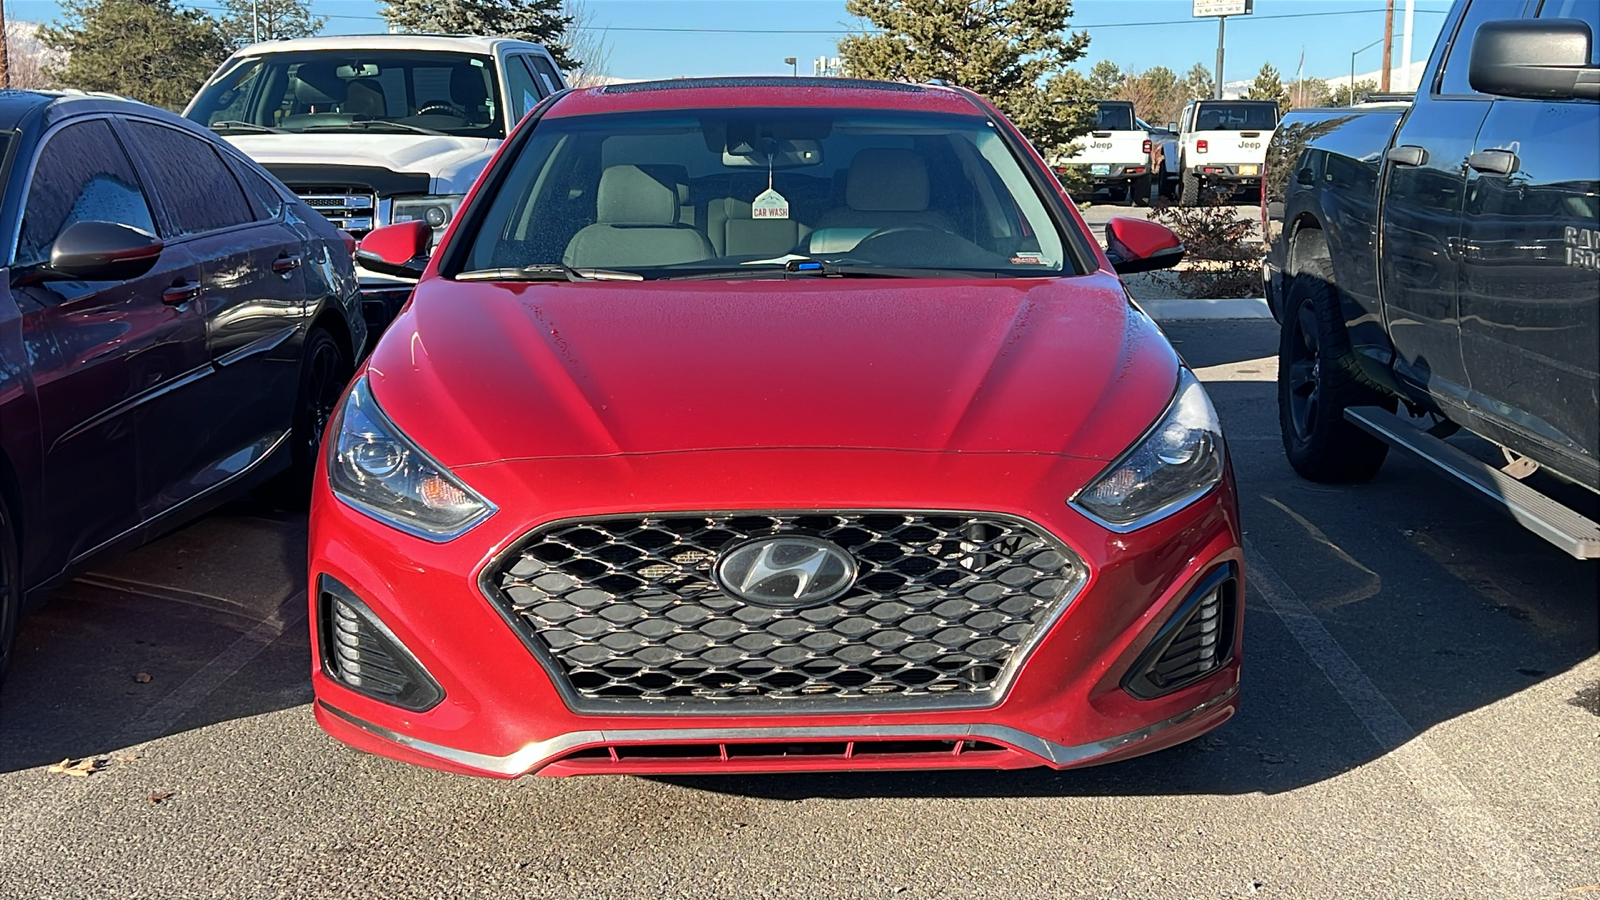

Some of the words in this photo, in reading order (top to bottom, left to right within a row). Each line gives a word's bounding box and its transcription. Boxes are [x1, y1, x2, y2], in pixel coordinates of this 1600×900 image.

[1090, 141, 1113, 150] Jeep
[1238, 141, 1261, 150] Jeep
[754, 208, 767, 217] CAR
[768, 208, 788, 217] WASH
